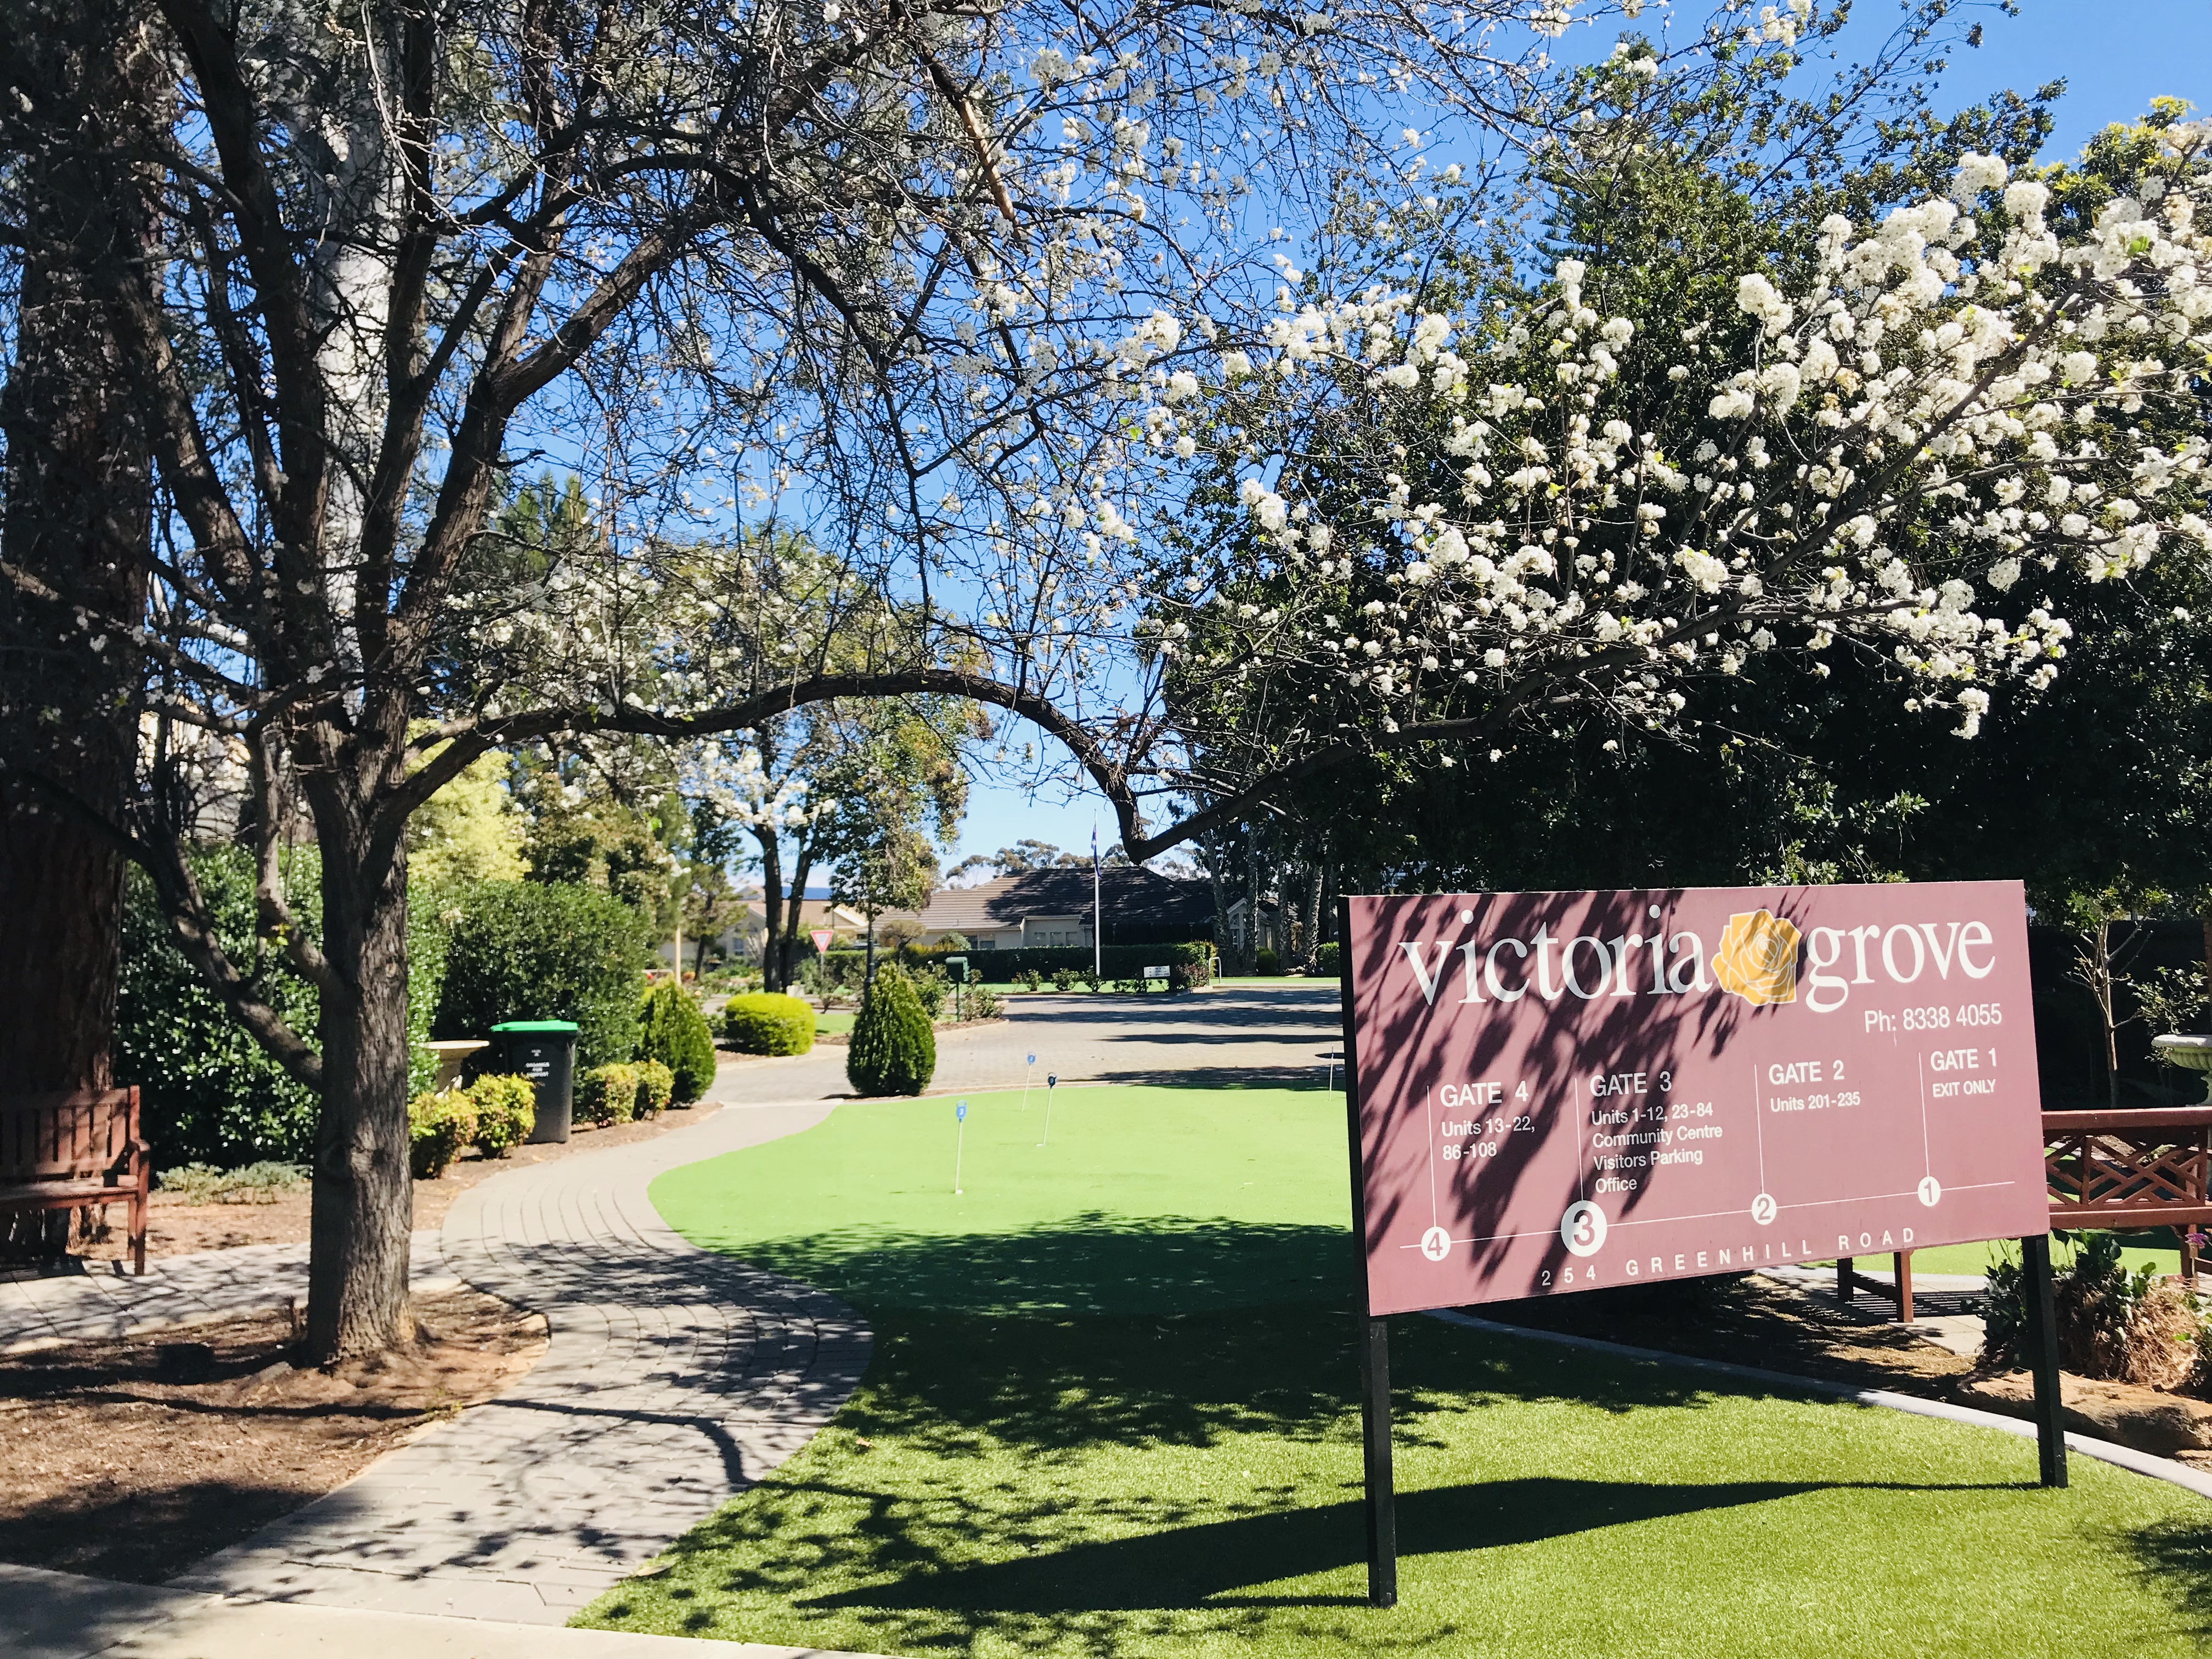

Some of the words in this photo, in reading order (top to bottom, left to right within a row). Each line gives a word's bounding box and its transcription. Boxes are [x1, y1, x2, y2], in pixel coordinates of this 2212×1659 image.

[1398, 904, 1713, 1006] victoria
[1805, 921, 1995, 1013] grove
[1865, 1009, 1897, 1032] Ph:
[1903, 1006, 1950, 1030] 8338
[1956, 1003, 2002, 1026] 4055
[1931, 1048, 1979, 1071] GATE
[1988, 1047, 1997, 1067] 1
[1590, 1072, 1647, 1097] GATE
[1660, 1071, 1672, 1092] 3
[1768, 1061, 1822, 1085] GATE
[1833, 1059, 1844, 1080] 2
[1440, 1081, 1502, 1107] GATE
[1515, 1081, 1528, 1101] 4
[1932, 1082, 1960, 1098] EXIT
[1963, 1079, 1996, 1095] ONLY
[1770, 1096, 1804, 1112] Units
[1808, 1091, 1861, 1109] 201-235
[1442, 1119, 1481, 1137] Units
[1485, 1115, 1536, 1134] 13-22,
[1592, 1107, 1628, 1126] Units
[1633, 1105, 1668, 1123] 1-12,
[1672, 1102, 1713, 1119] 23-84
[1593, 1129, 1673, 1149] Community
[1677, 1124, 1723, 1140] Centre
[1442, 1142, 1497, 1160] 86-108
[1593, 1152, 1646, 1170] Visitors
[1651, 1148, 1703, 1165] Parking
[1595, 1177, 1638, 1193] Office
[1923, 1181, 1933, 1203] 1
[1757, 1197, 1771, 1220] 2
[1573, 1210, 1595, 1246] 3
[1427, 1232, 1443, 1256] 4
[1626, 1239, 1812, 1277] GREENHILL
[1838, 1227, 1914, 1251] ROAD
